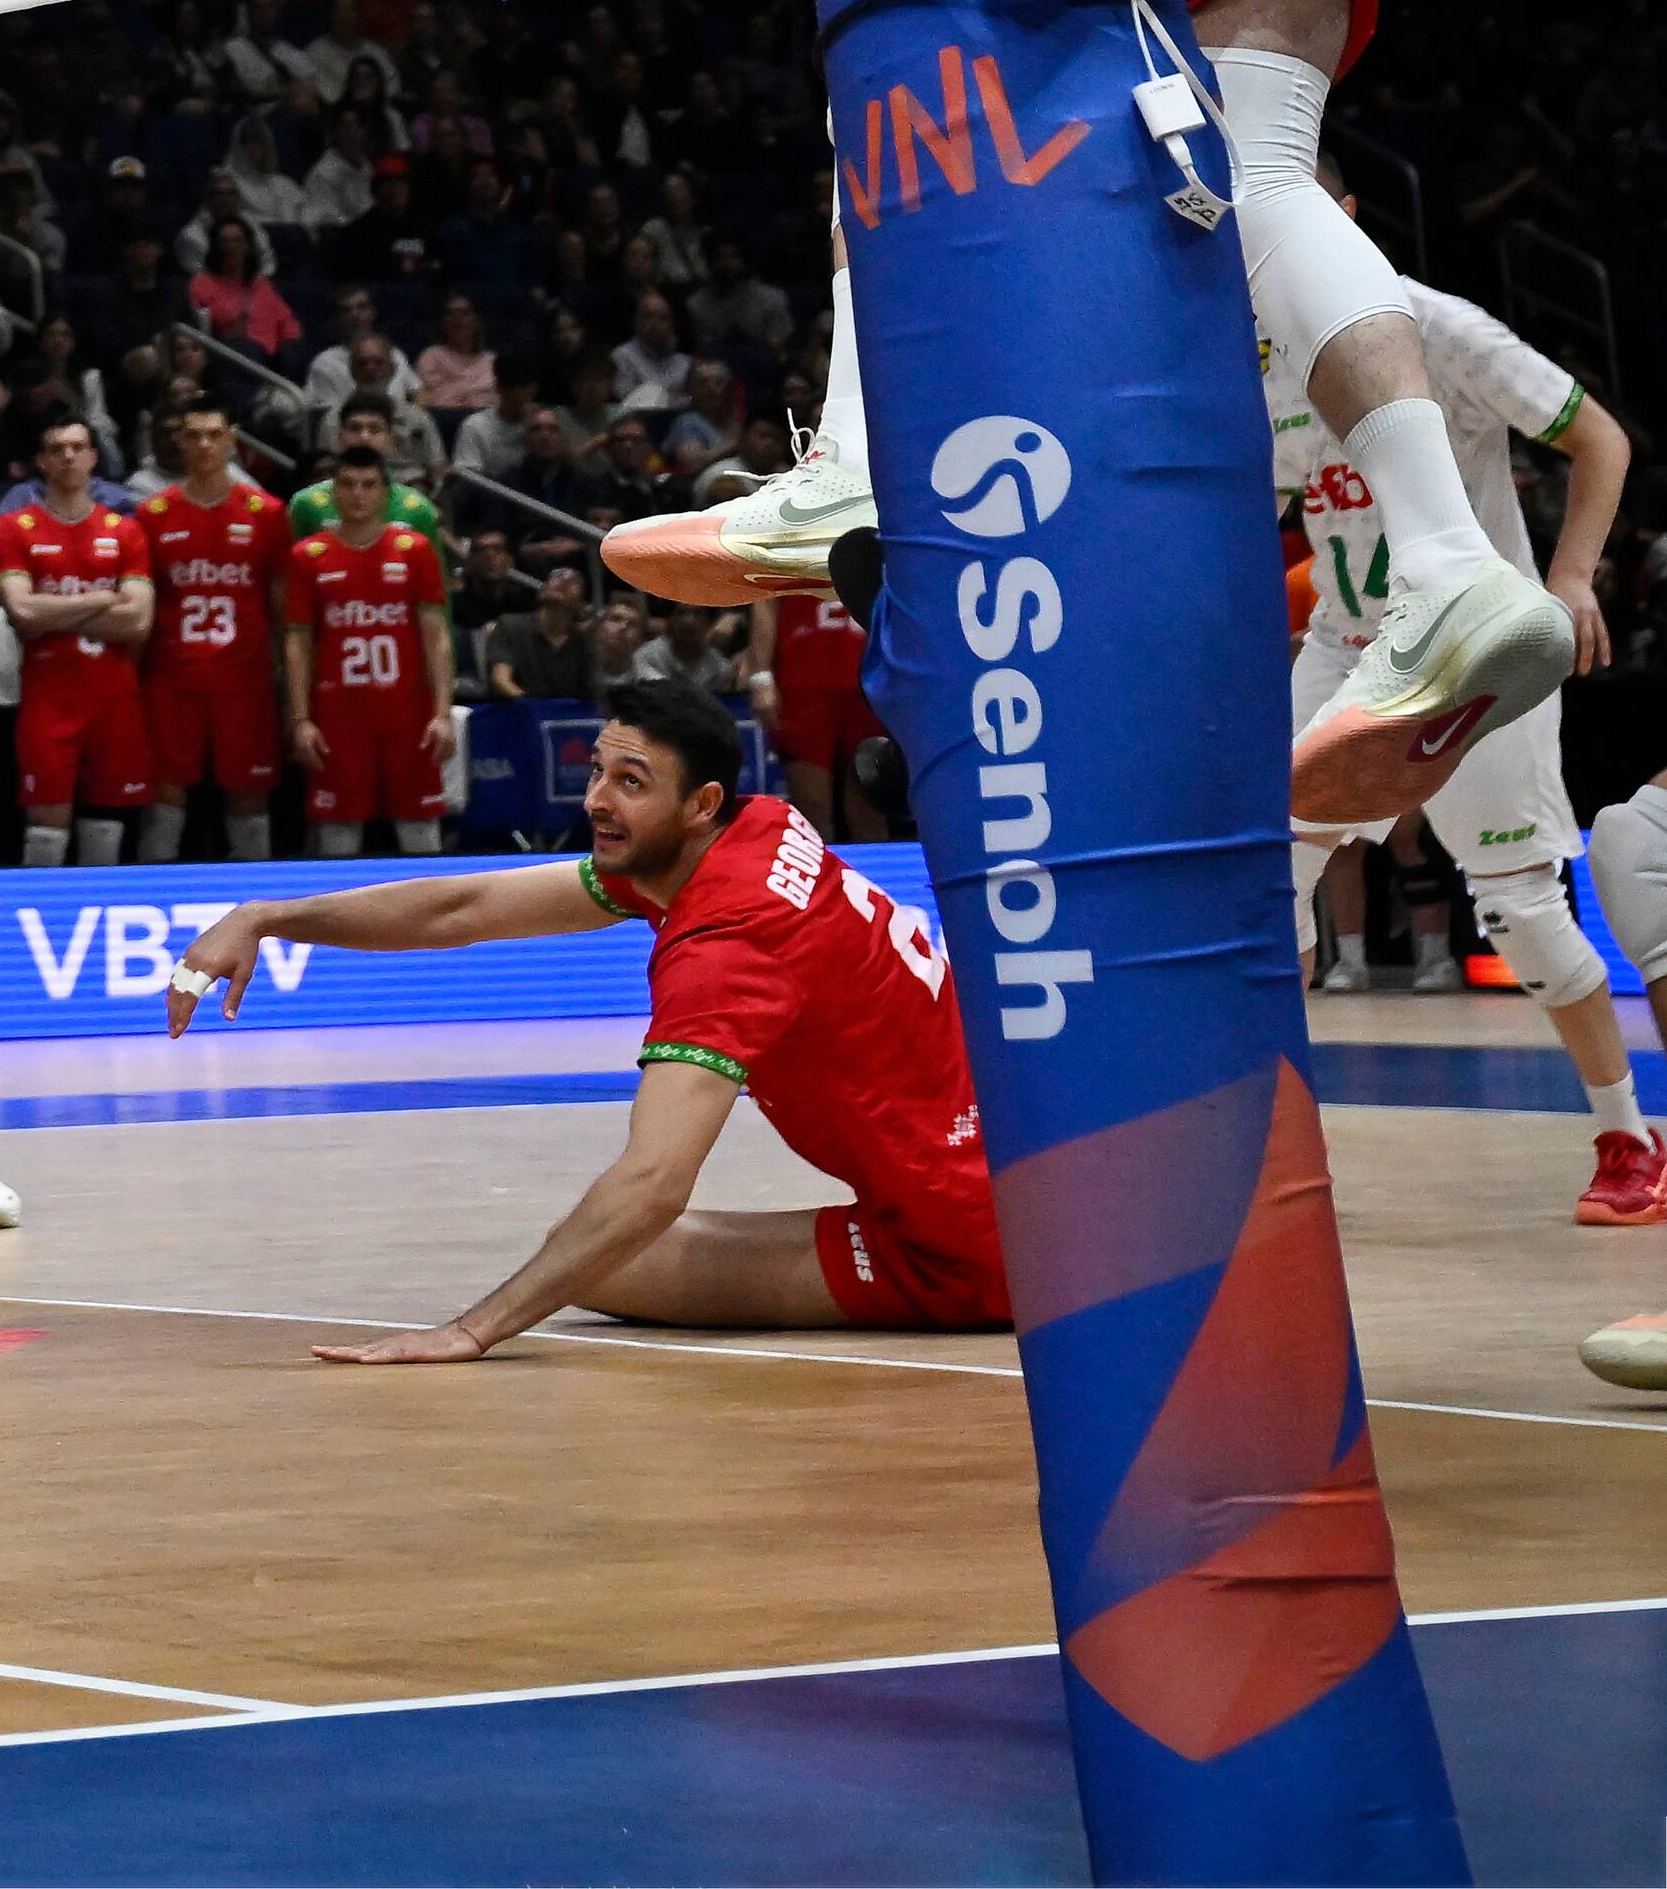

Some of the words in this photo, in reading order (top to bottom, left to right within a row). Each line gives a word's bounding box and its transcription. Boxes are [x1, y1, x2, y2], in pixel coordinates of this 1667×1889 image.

[842, 45, 1091, 232] VNL
[180, 594, 237, 646] 23
[341, 634, 401, 688] 20
[957, 556, 1094, 1042] Senoh
